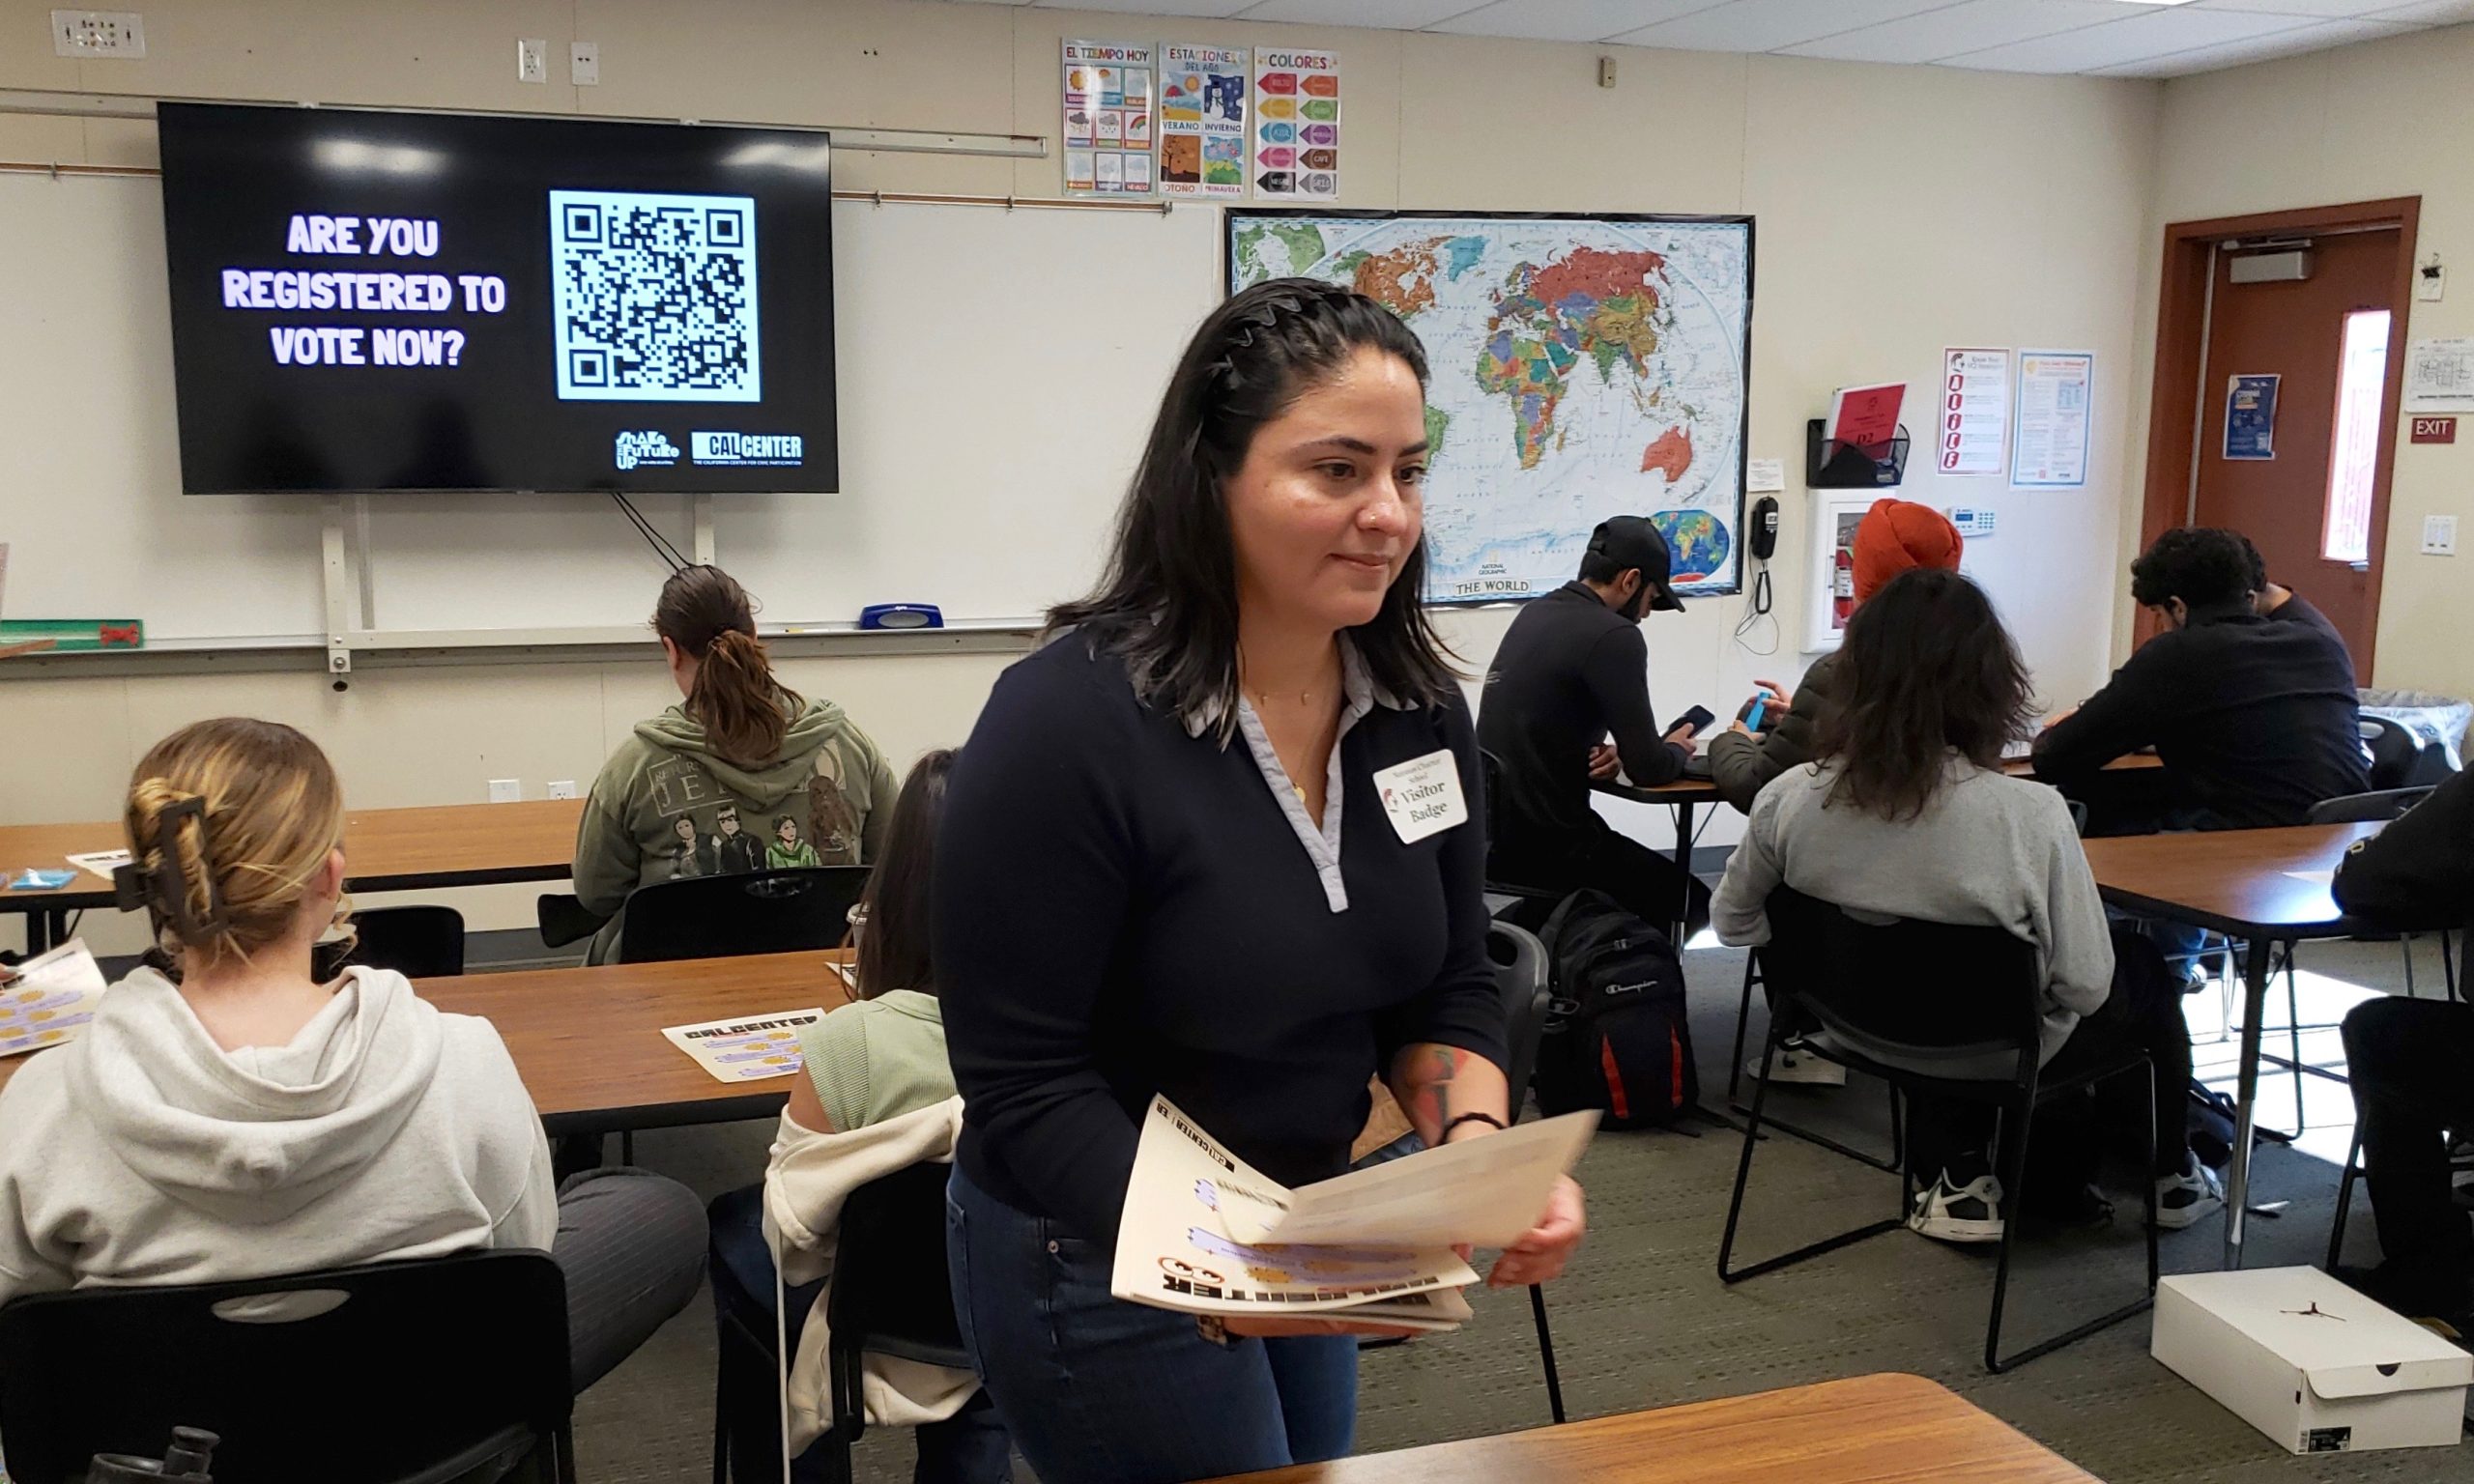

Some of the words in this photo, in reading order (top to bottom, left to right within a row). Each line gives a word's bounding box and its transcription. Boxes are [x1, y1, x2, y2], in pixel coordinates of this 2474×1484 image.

[1067, 46, 1078, 58] EL
[1081, 47, 1124, 60] TIEMPO
[1127, 49, 1149, 62] HOY
[1269, 54, 1327, 70] COLORES
[1163, 122, 1199, 130] VERANO
[1205, 124, 1242, 132] INVIERNO
[287, 214, 361, 254] ARE
[367, 217, 439, 257] YOU
[222, 269, 452, 311] REGISTERED
[458, 274, 505, 313] TO
[271, 328, 365, 365] VOTE
[372, 328, 465, 366] NOW?
[2416, 419, 2451, 436] EXIT
[1455, 582, 1481, 595] THE
[1484, 580, 1529, 592] WORLD
[1400, 782, 1446, 804] Visitor
[1409, 803, 1449, 823] Badge
